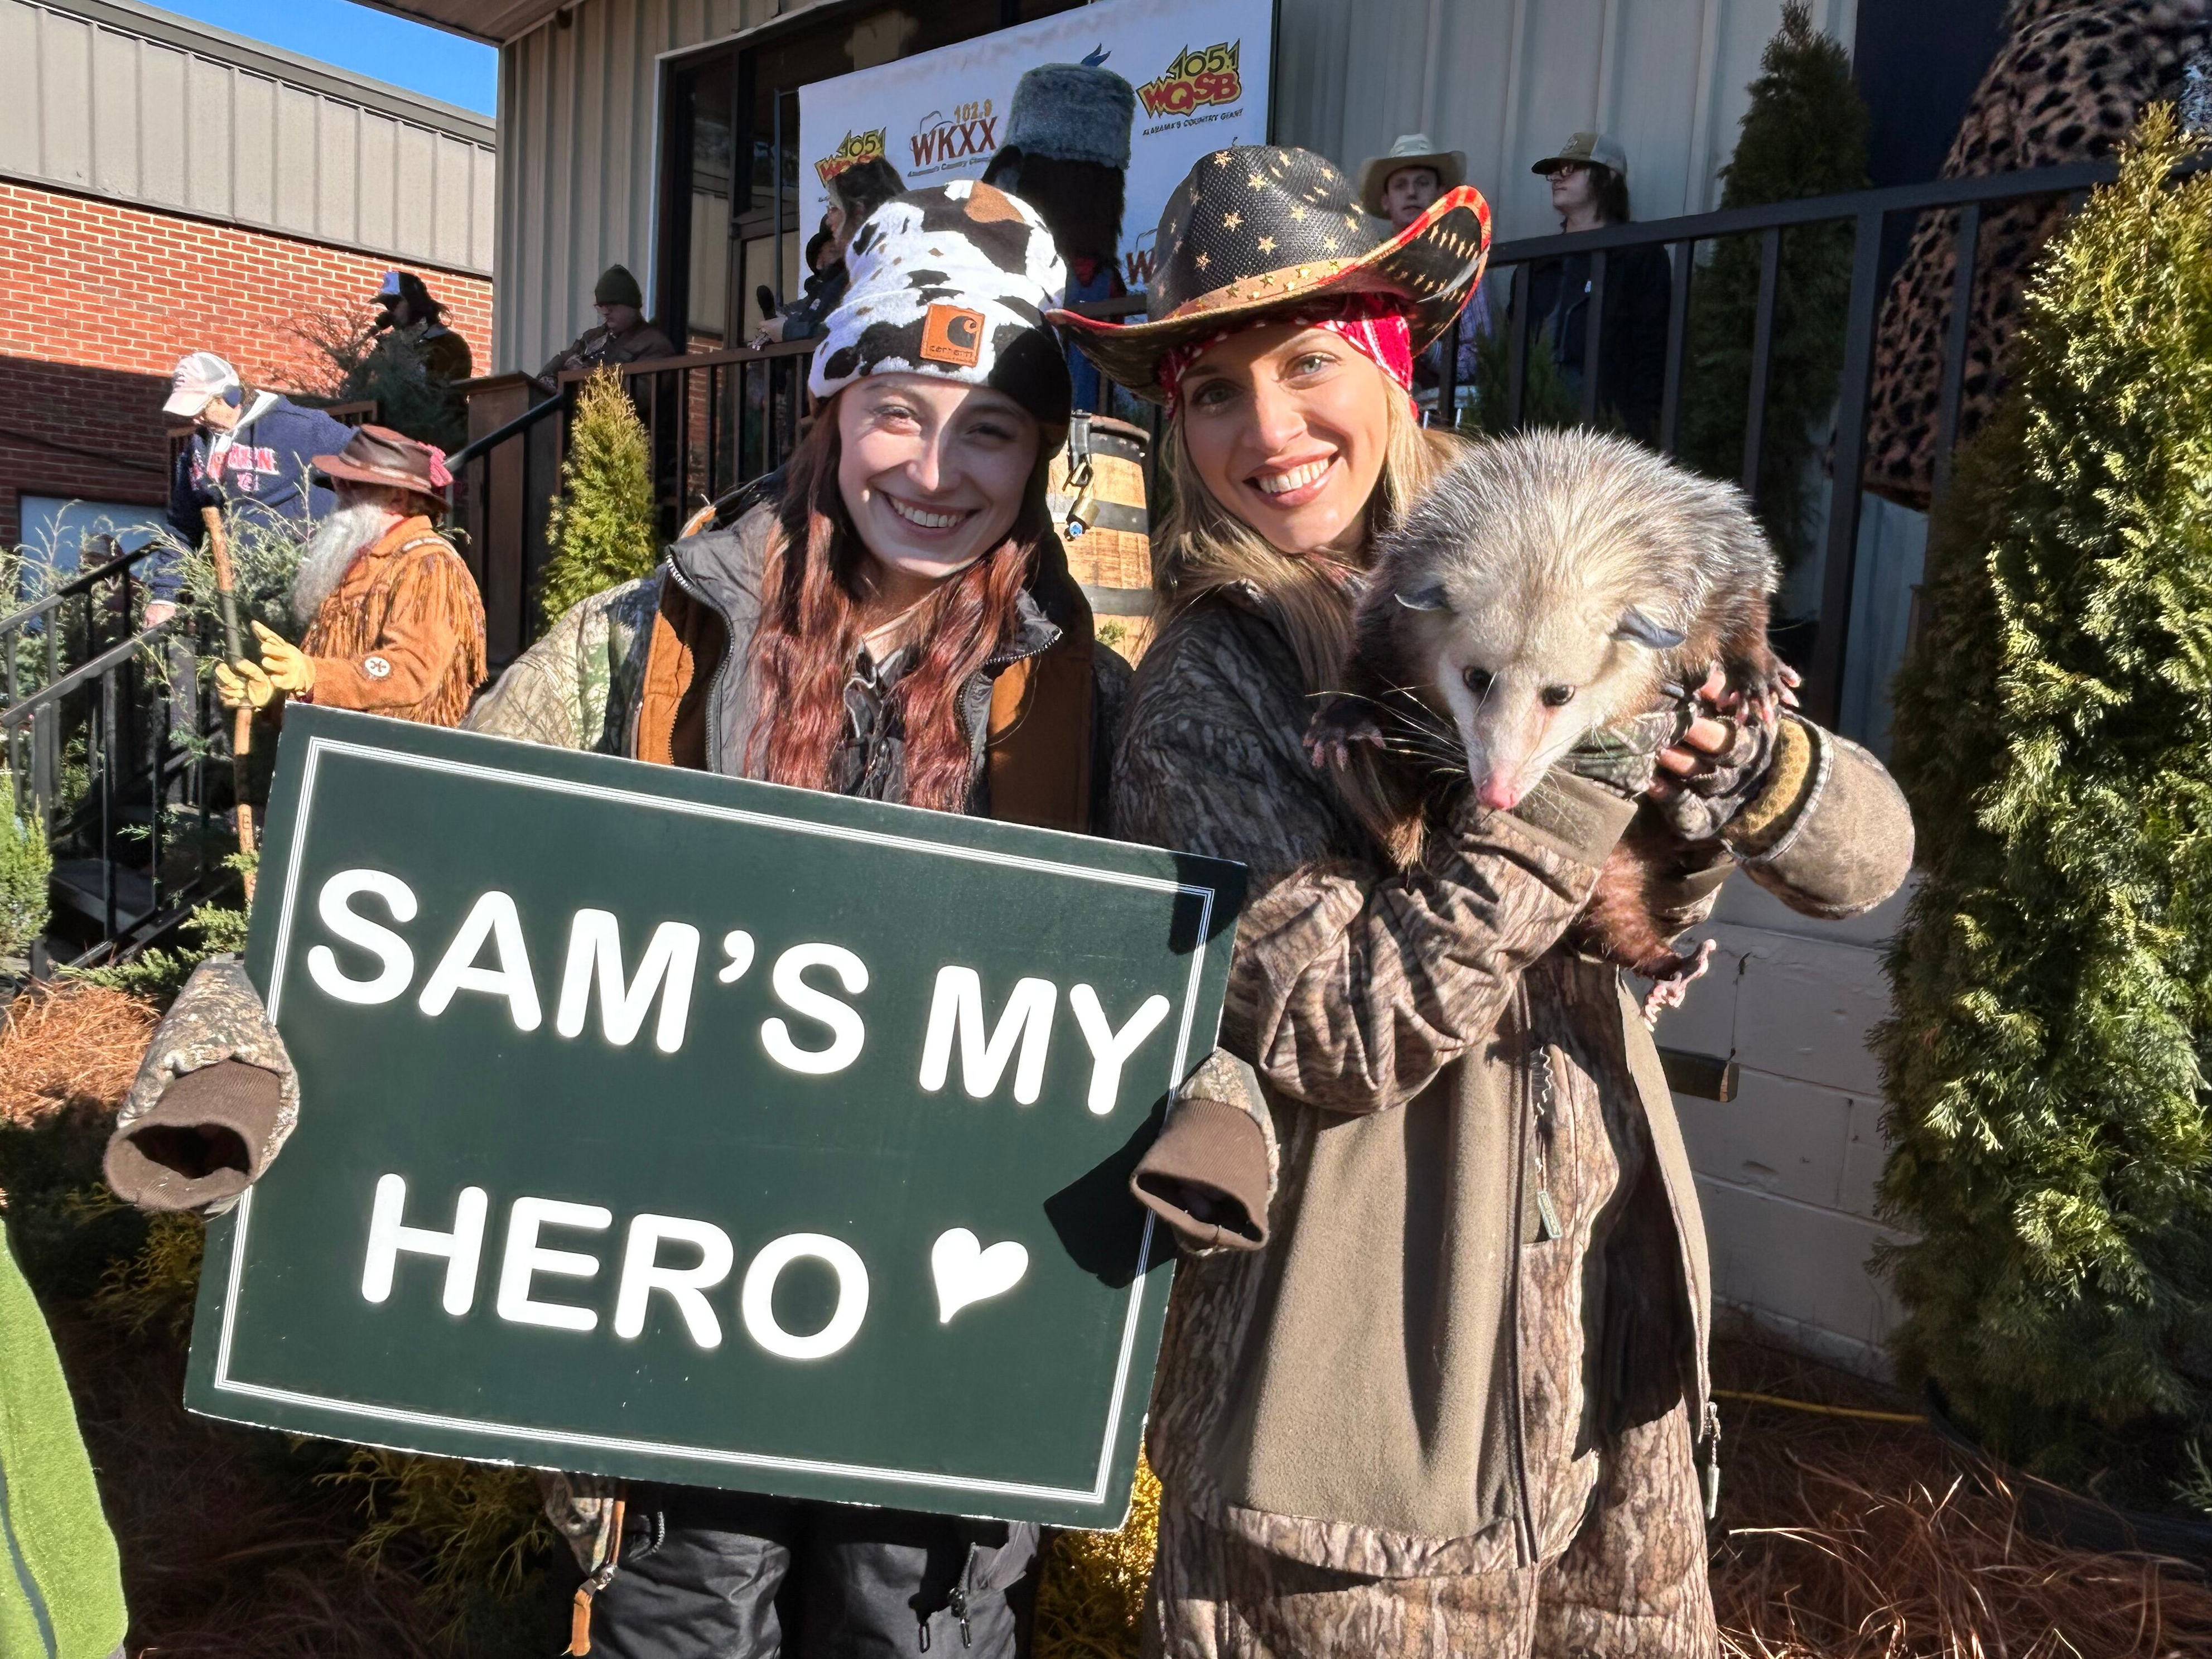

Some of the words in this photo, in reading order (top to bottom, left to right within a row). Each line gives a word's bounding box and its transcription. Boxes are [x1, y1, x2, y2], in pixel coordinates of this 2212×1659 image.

[1170, 44, 1238, 79] 105.1
[954, 98, 992, 124] 102.9
[1142, 71, 1240, 112] WQSB
[911, 116, 999, 167] WKXX
[307, 869, 869, 1075] SAM'S
[919, 965, 1170, 1115] MY
[362, 1173, 869, 1359] HERO
